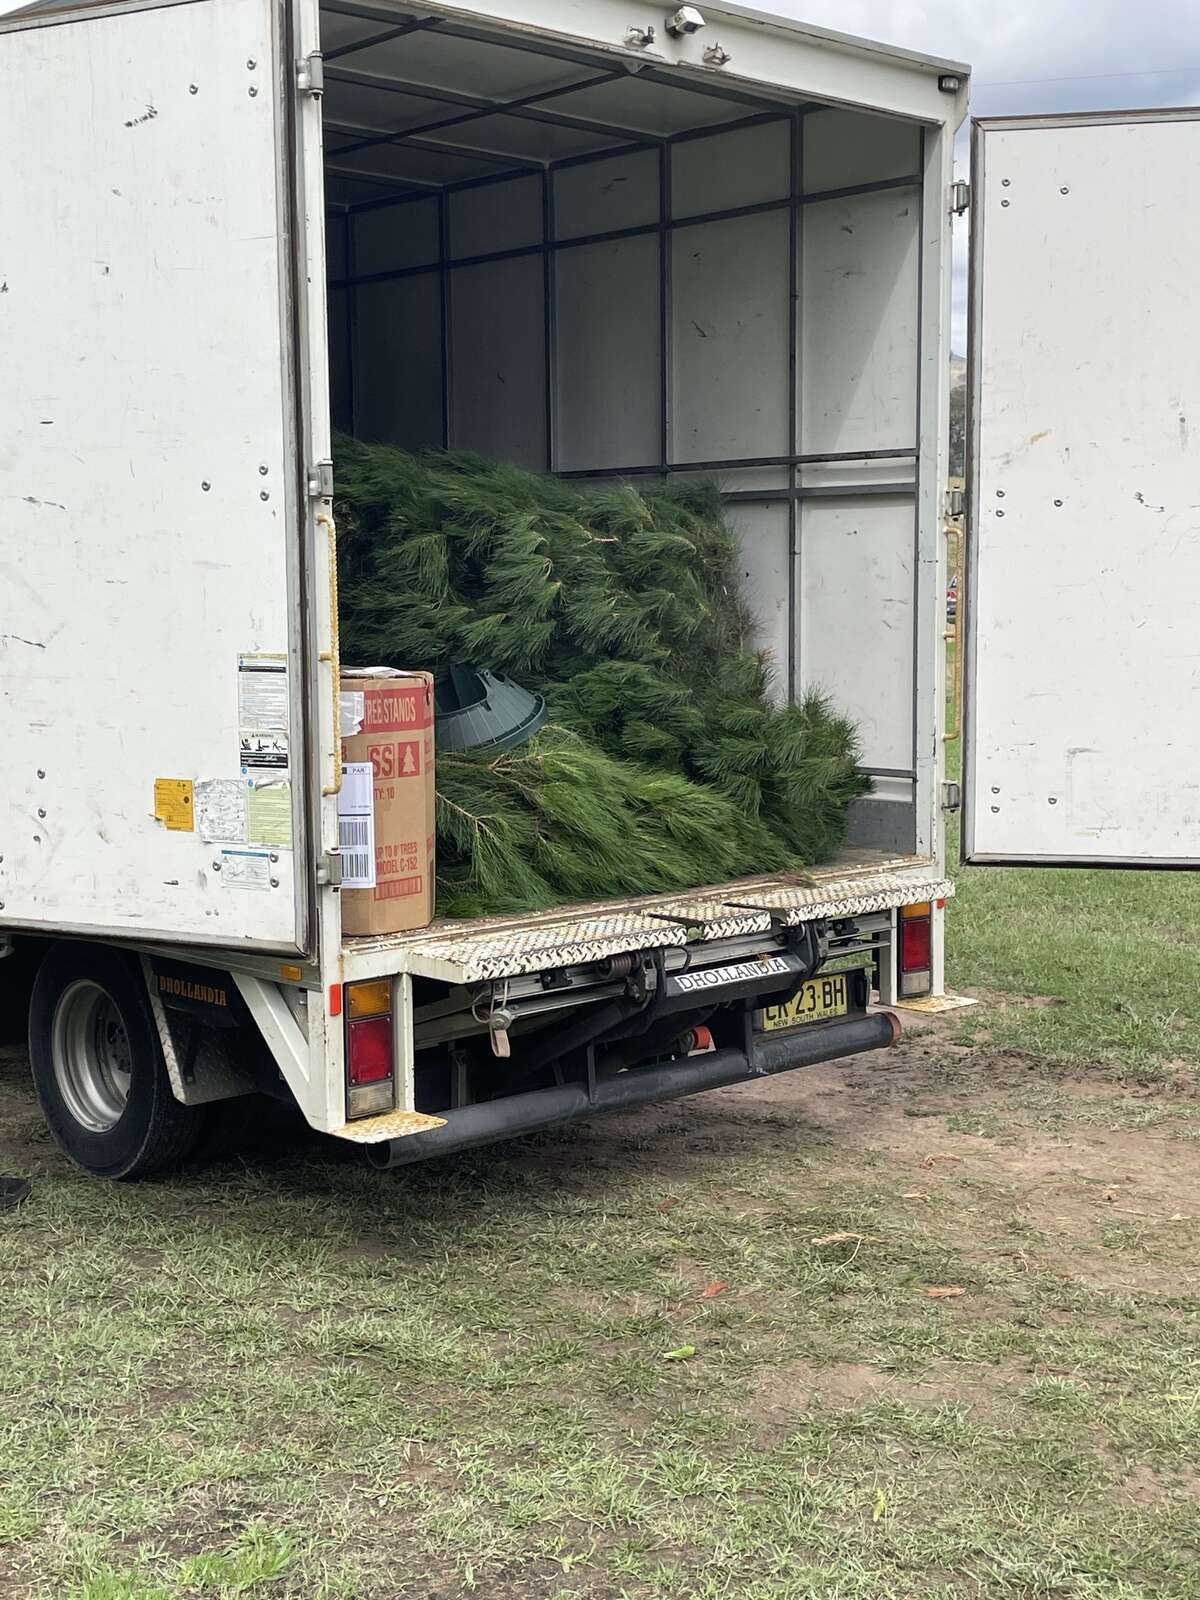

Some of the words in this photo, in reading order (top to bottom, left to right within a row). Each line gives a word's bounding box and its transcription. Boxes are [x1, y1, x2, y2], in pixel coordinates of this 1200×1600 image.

[364, 698, 382, 725] REE
[383, 696, 416, 723] STANDS
[400, 841, 417, 856] TREES
[400, 856, 418, 873] C-152
[677, 958, 787, 990] DHOLLANDIA
[160, 975, 227, 1006] DHOLLANDIA
[773, 1018, 789, 1028] NEW
[791, 1013, 814, 1025] SOUTH
[816, 1007, 839, 1018] WALES
